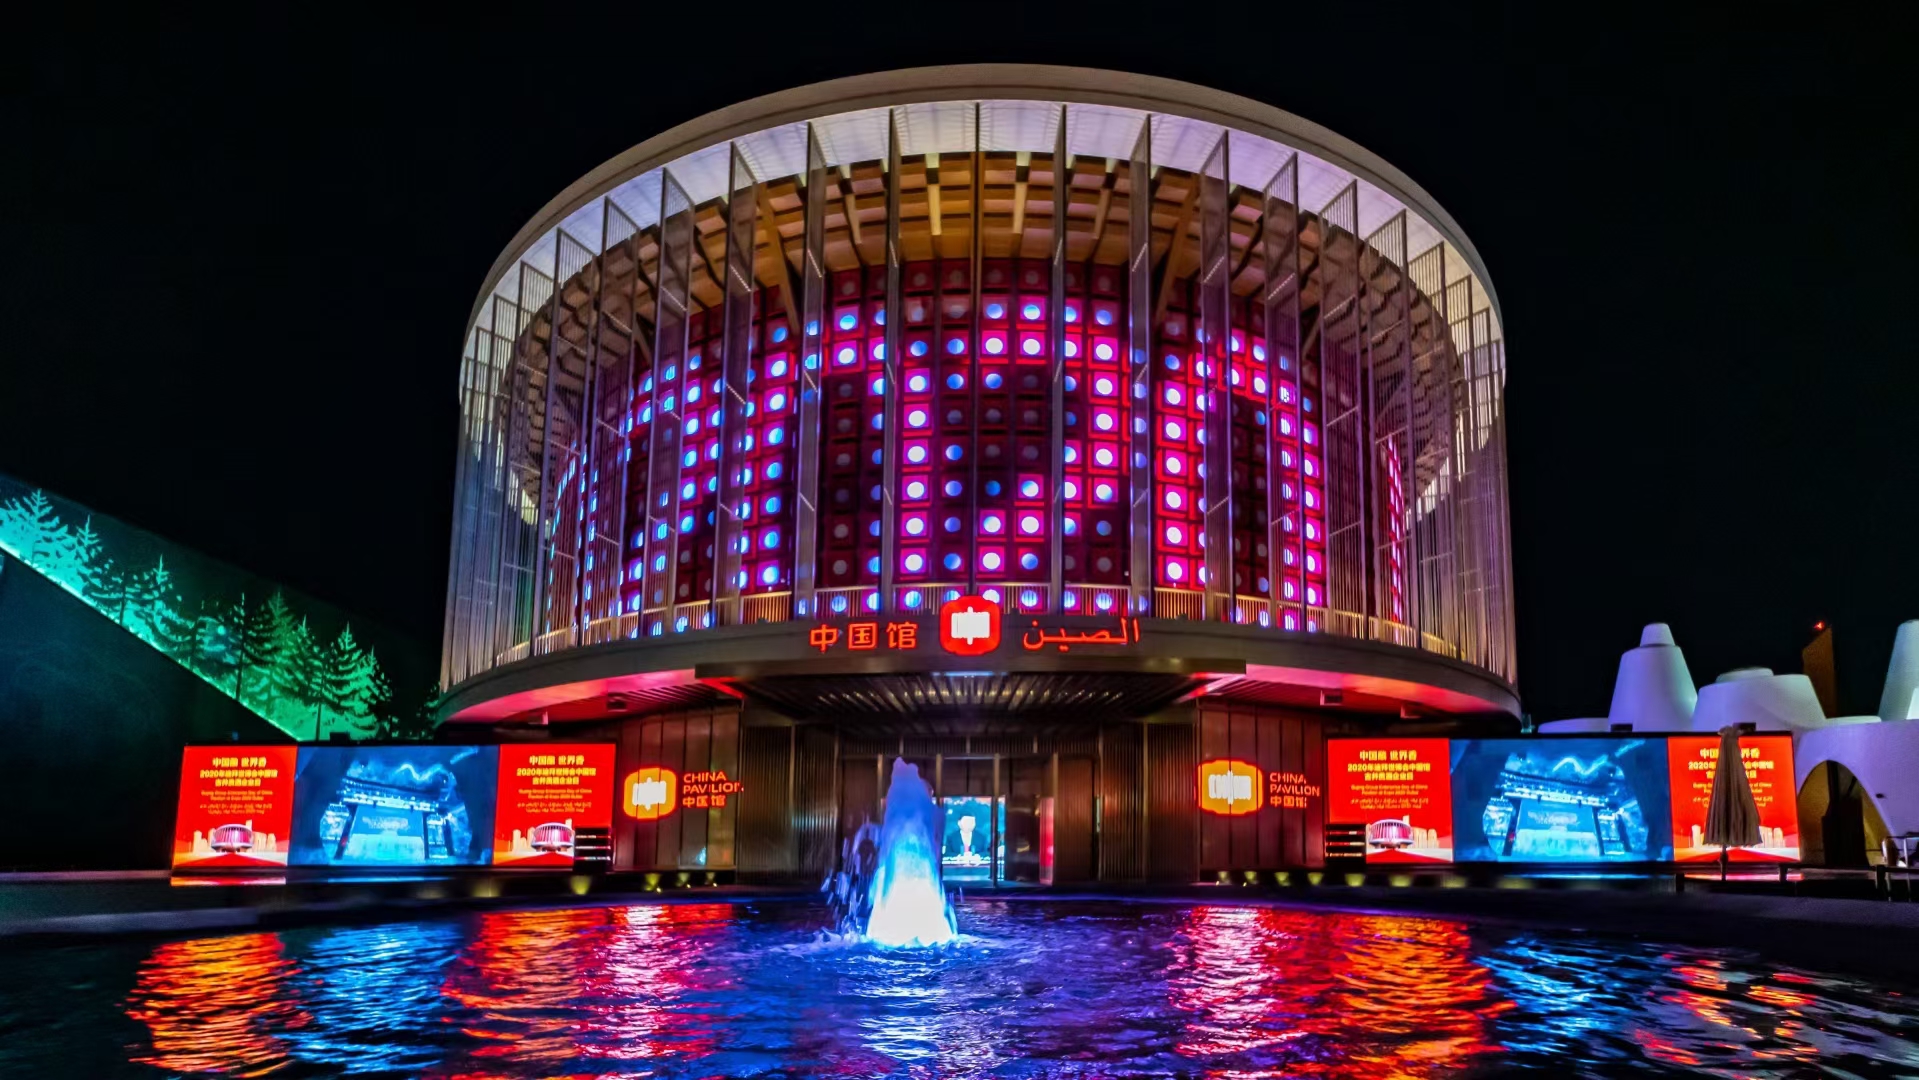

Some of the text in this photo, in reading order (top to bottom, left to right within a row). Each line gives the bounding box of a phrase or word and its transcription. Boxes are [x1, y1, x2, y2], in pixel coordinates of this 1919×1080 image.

[810, 622, 918, 652] 中国馆
[1023, 617, 1141, 652] الصين
[683, 771, 727, 784] CHINA
[1269, 772, 1307, 784] CHINA
[1269, 783, 1321, 797] PAVILION
[682, 794, 727, 808] 中国馆
[1270, 795, 1307, 808] 中国馆
